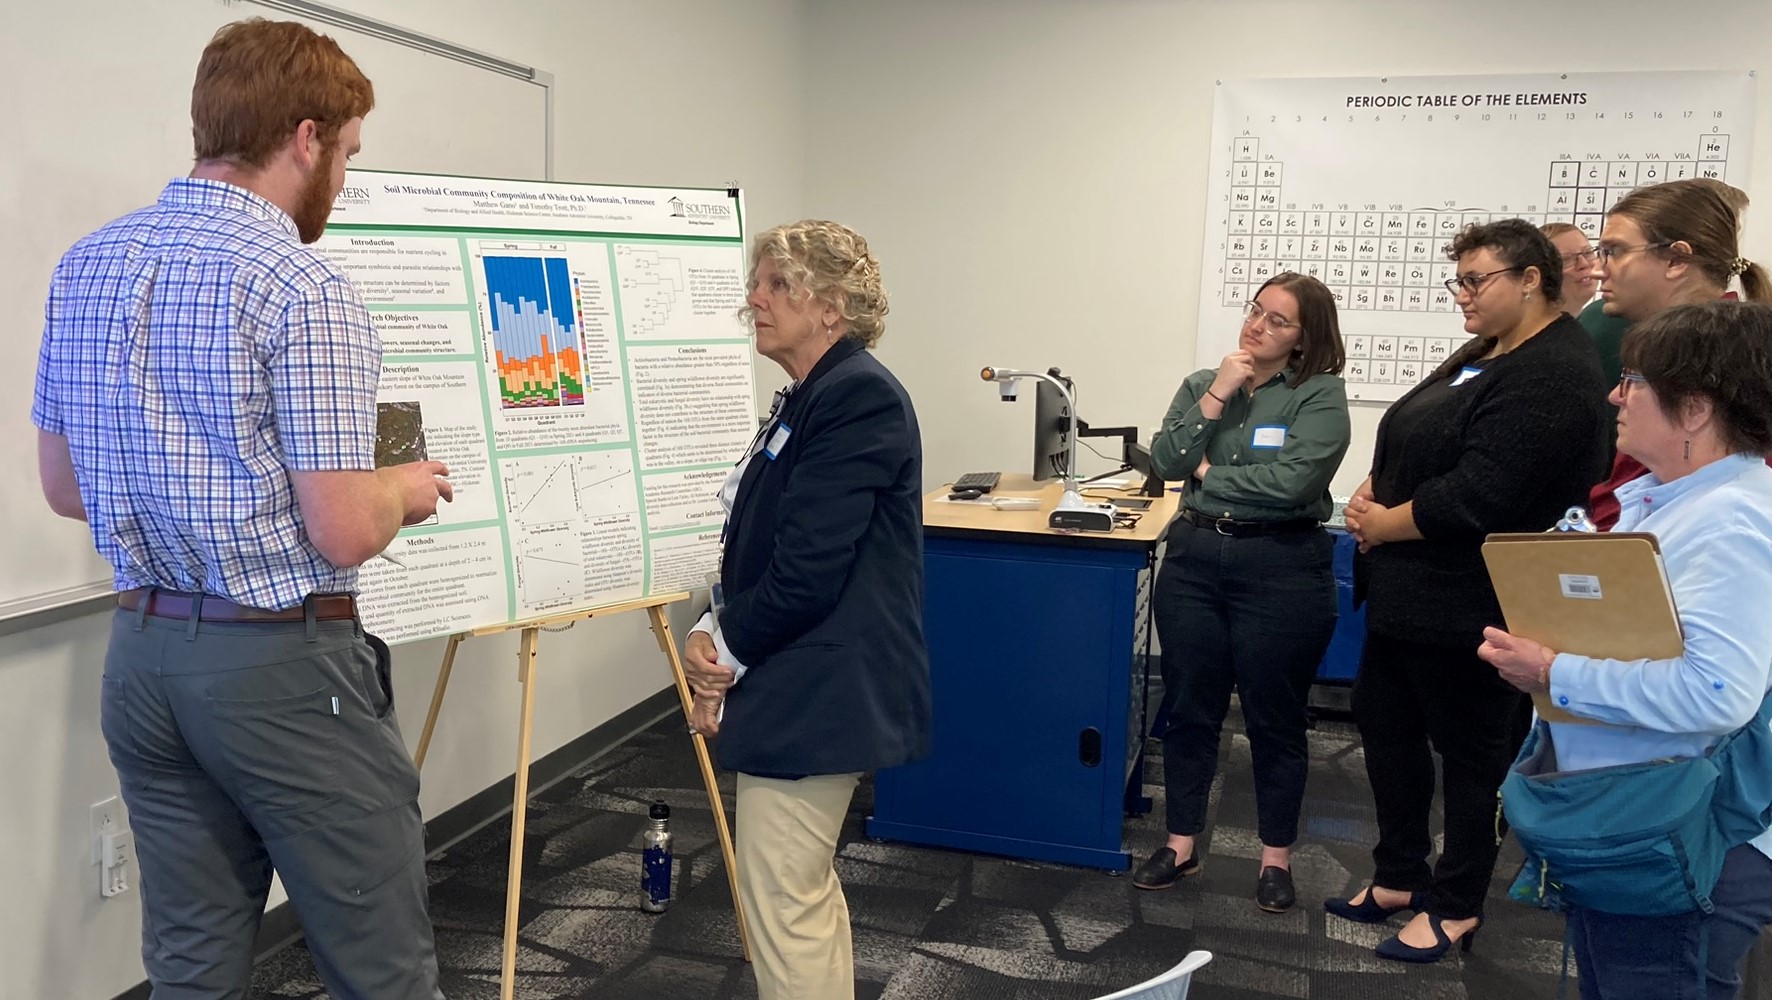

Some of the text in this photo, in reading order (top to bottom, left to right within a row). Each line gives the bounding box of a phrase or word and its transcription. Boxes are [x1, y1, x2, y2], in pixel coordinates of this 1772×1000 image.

[1347, 93, 1587, 107] PERIODIC TABLE OF THE ELEMENTS
[1537, 113, 1546, 121] 12
[1566, 112, 1575, 120] 13
[1654, 111, 1663, 119] 16
[1683, 111, 1692, 119] 17
[1713, 111, 1722, 119] 18
[1647, 170, 1656, 178] O
[1679, 170, 1684, 178] F
[384, 185, 655, 206] Soil Microbial Community Composition of White Oak Mountain, Tennessee
[1261, 195, 1275, 203] Mg
[531, 203, 553, 212] Timothy
[686, 204, 730, 215] SOUTHERN
[1259, 219, 1272, 227] Ca
[1286, 219, 1296, 227] Sc
[1363, 220, 1374, 228] Cr
[1441, 221, 1455, 229] Co
[1580, 222, 1595, 230] Ge
[1260, 243, 1268, 251] Sr
[1334, 244, 1347, 252] Nb
[1359, 245, 1373, 253] Mo
[1388, 245, 1397, 253] Tc
[1232, 267, 1242, 275] Cs
[1333, 269, 1343, 277] Ta
[1360, 269, 1369, 277] W
[1411, 270, 1423, 278] Os
[1232, 291, 1239, 299] Fr
[1357, 294, 1368, 303] Sg
[1410, 295, 1420, 303] Hs
[385, 314, 419, 322] Objectives
[382, 366, 420, 374] Description
[1402, 369, 1415, 377] Np
[407, 538, 434, 546] Methods
